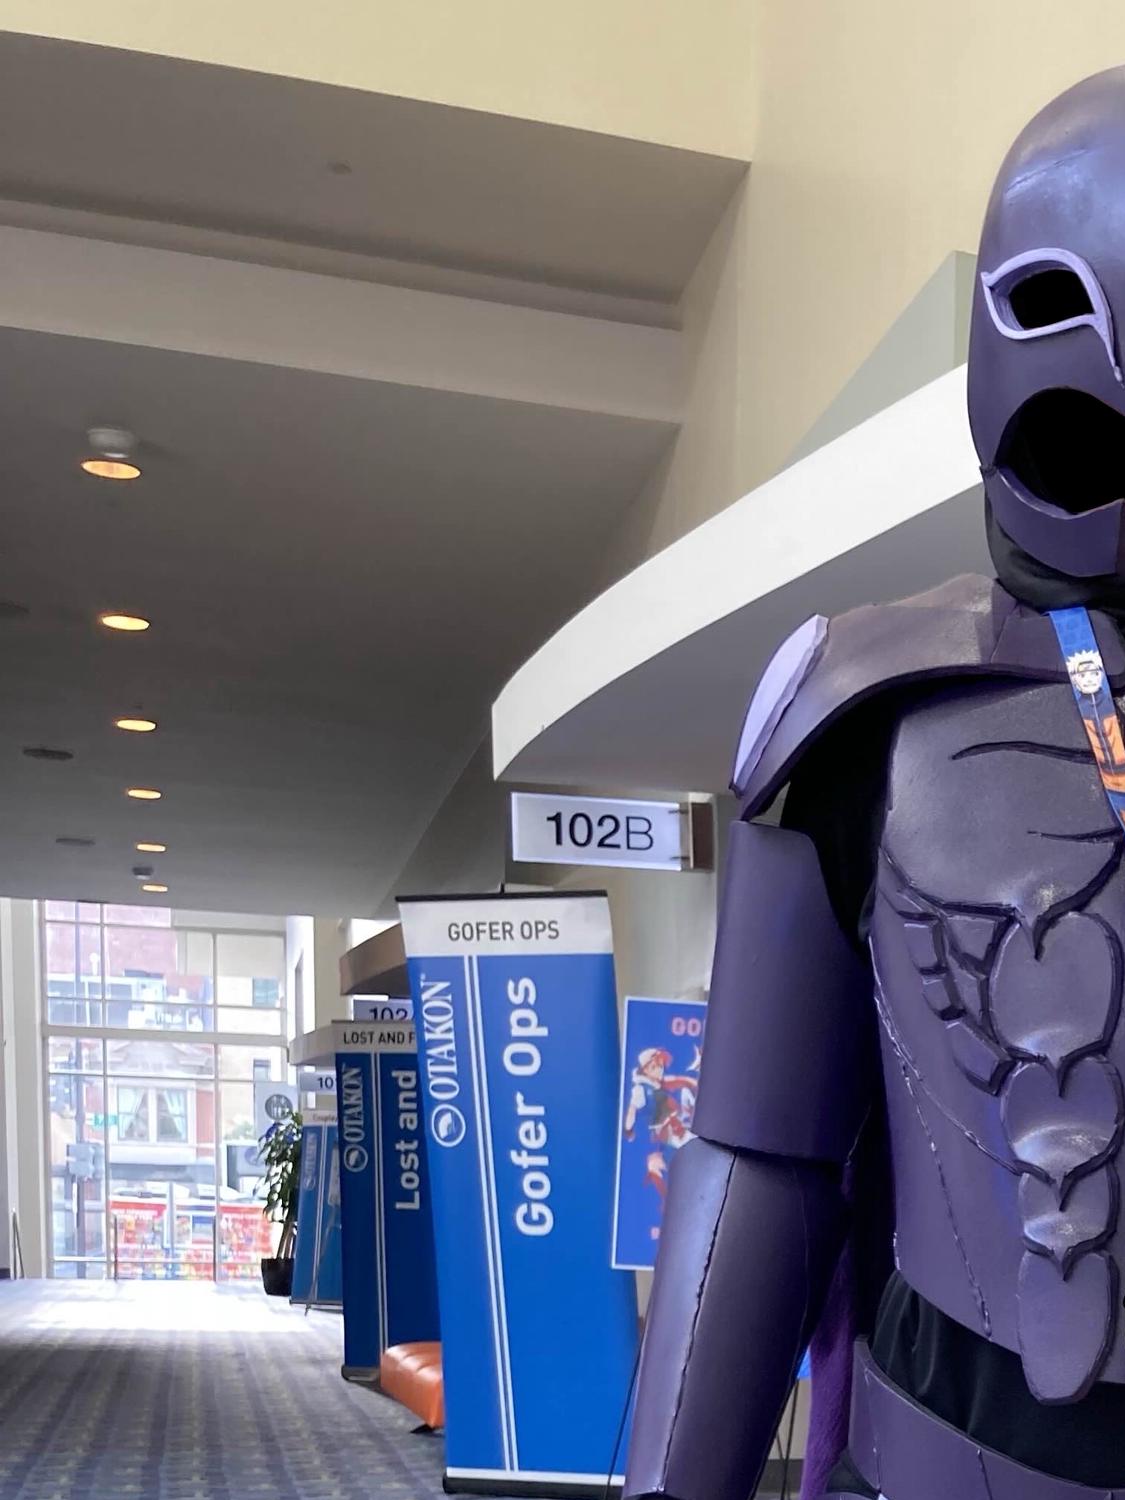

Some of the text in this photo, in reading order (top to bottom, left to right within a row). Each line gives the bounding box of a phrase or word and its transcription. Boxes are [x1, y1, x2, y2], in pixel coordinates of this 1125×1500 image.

[546, 812, 655, 851] 102B
[447, 919, 560, 942] GOFER OPS
[343, 1031, 375, 1045] LOST
[378, 1031, 405, 1045] AND
[420, 980, 460, 1100] OTAKON
[317, 1076, 335, 1089] 10
[342, 1067, 366, 1143] OTAKON
[502, 976, 555, 1238] Gofer Ops
[391, 1069, 421, 1211] Lost and
